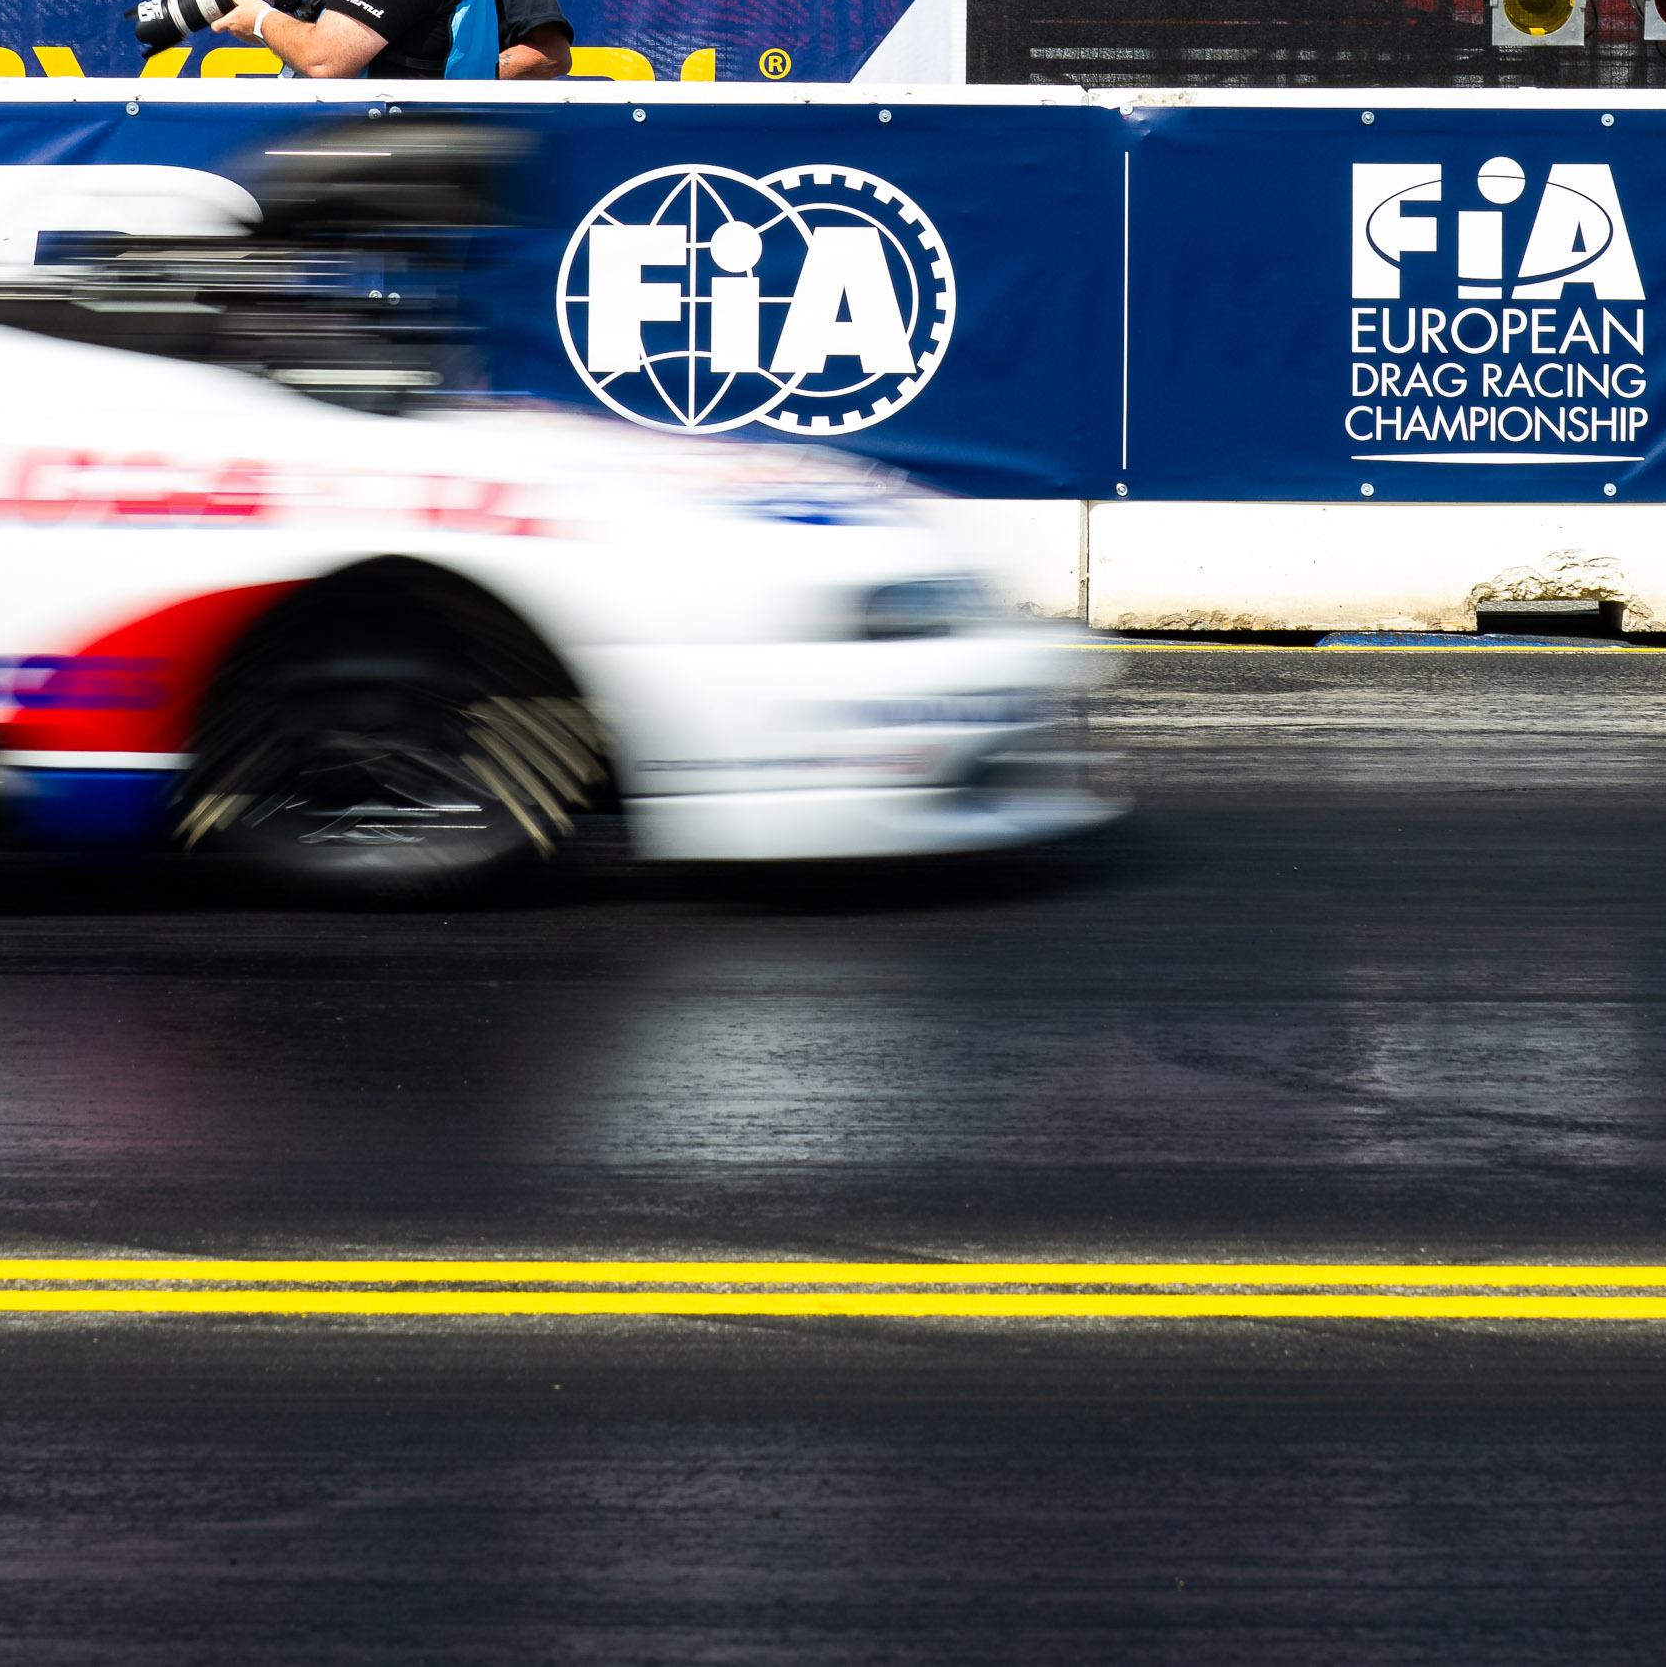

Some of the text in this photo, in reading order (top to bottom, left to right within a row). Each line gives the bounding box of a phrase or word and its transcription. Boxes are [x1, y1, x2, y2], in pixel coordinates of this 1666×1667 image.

[1351, 307, 1645, 355] EUROPEAN
[1352, 362, 1646, 399] DRAG RACING
[1345, 405, 1648, 442] CHAMPIONSHIP
